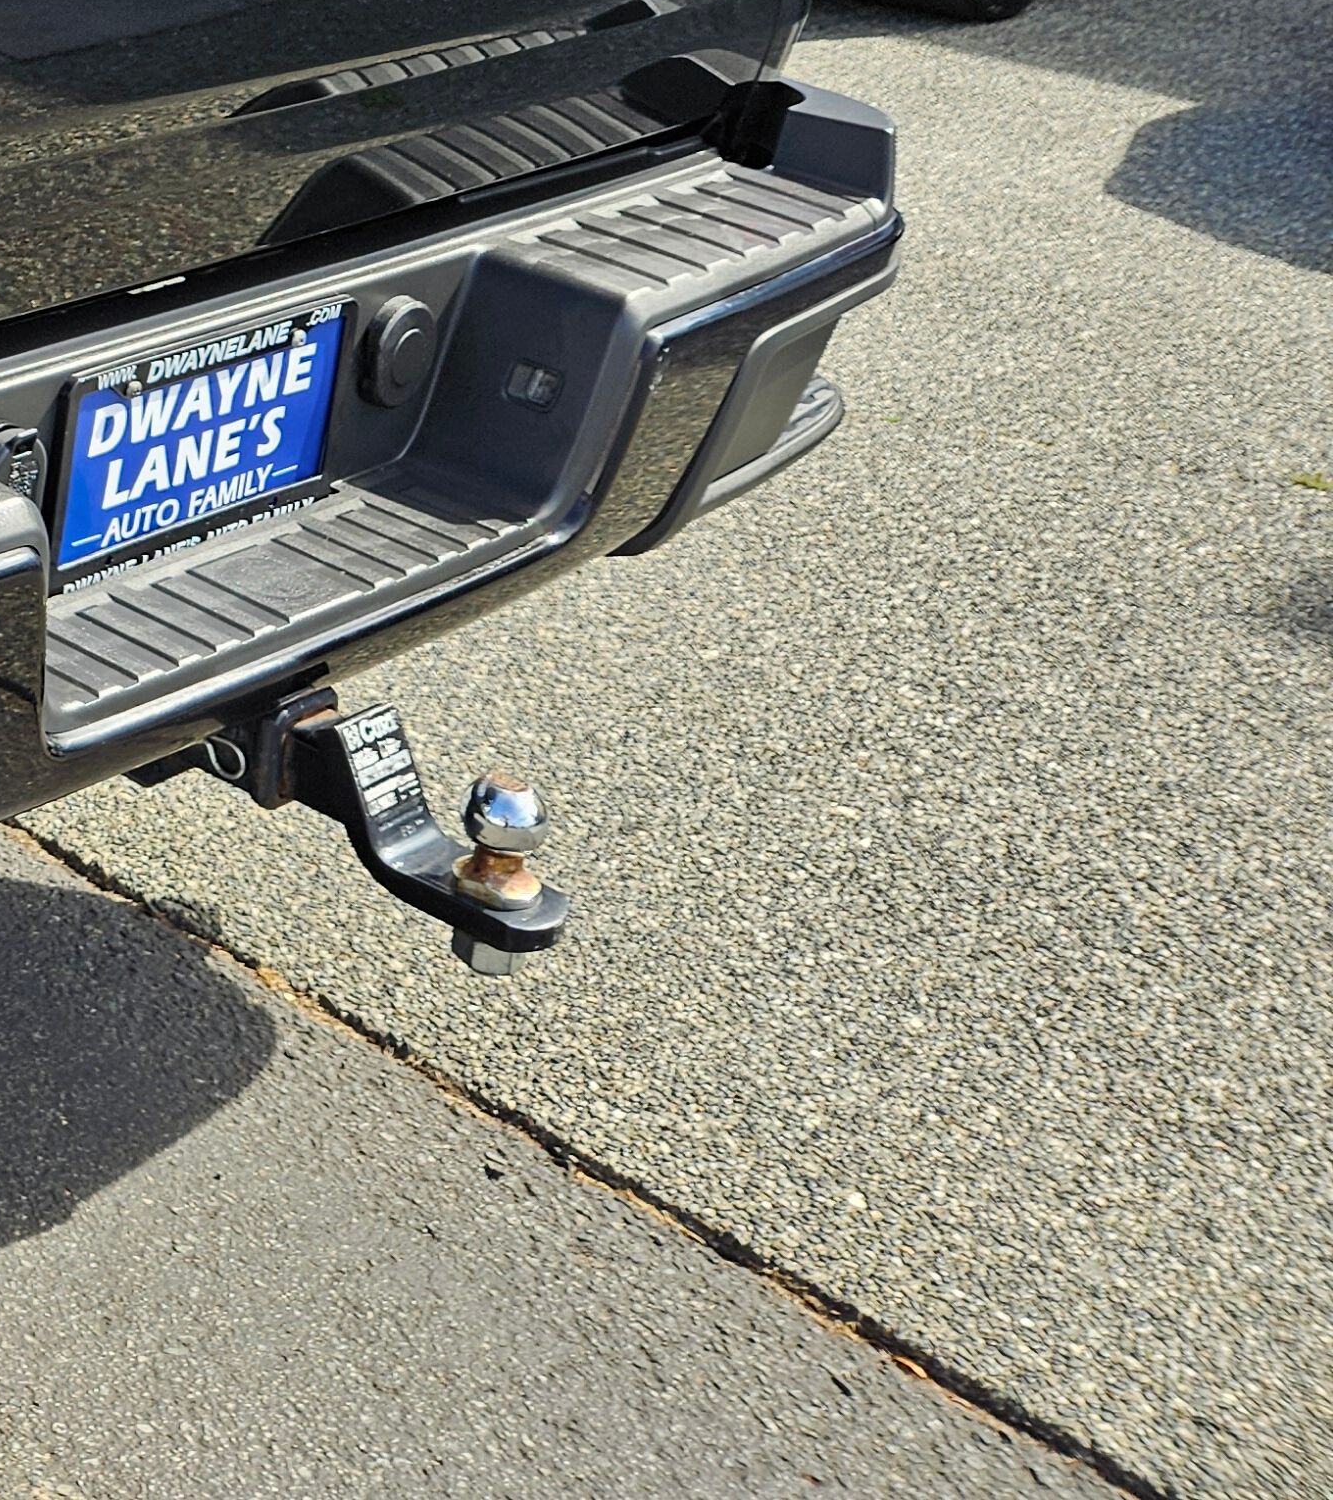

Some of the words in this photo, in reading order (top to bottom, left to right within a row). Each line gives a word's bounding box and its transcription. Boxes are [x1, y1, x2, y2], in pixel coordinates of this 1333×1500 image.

[146, 320, 293, 384] DWAYNELANE
[87, 343, 318, 458] DWAYNE
[100, 498, 180, 548] AUTO
[187, 463, 274, 518] FAMILY
[101, 406, 286, 511] LANE'S
